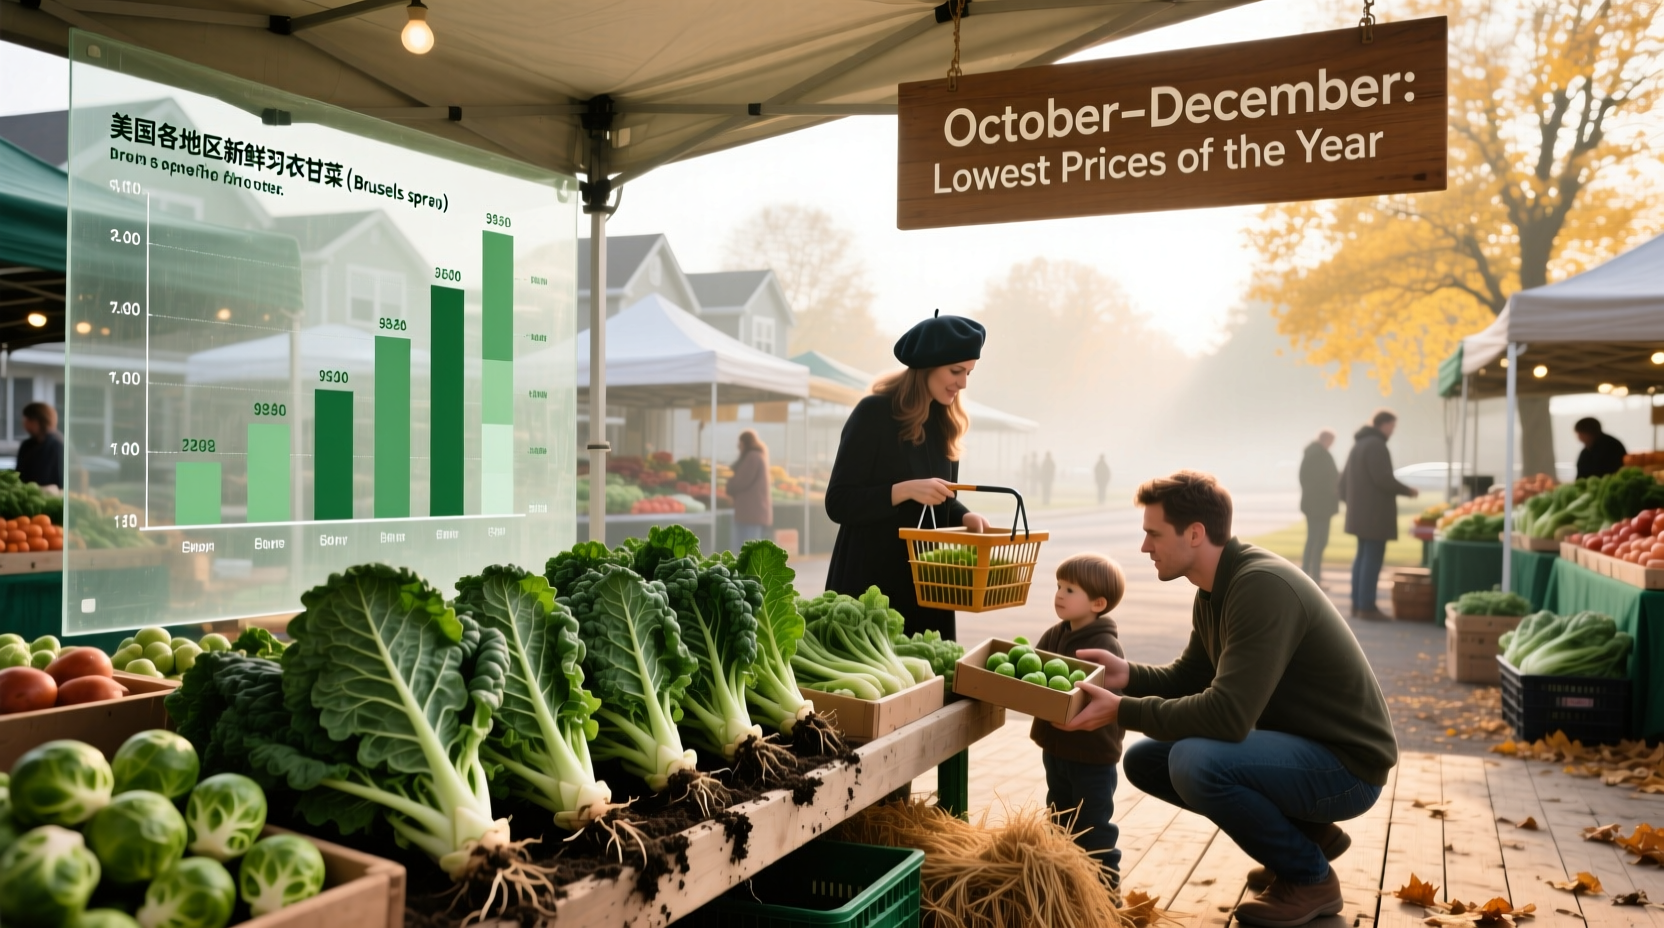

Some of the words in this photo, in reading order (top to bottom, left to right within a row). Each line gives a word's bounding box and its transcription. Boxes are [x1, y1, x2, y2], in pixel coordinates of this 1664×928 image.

[934, 154, 1051, 194] Lowest
[1062, 146, 1166, 183] Prices
[1177, 137, 1214, 174] of
[1224, 133, 1286, 169] the
[1296, 127, 1384, 164] Year
